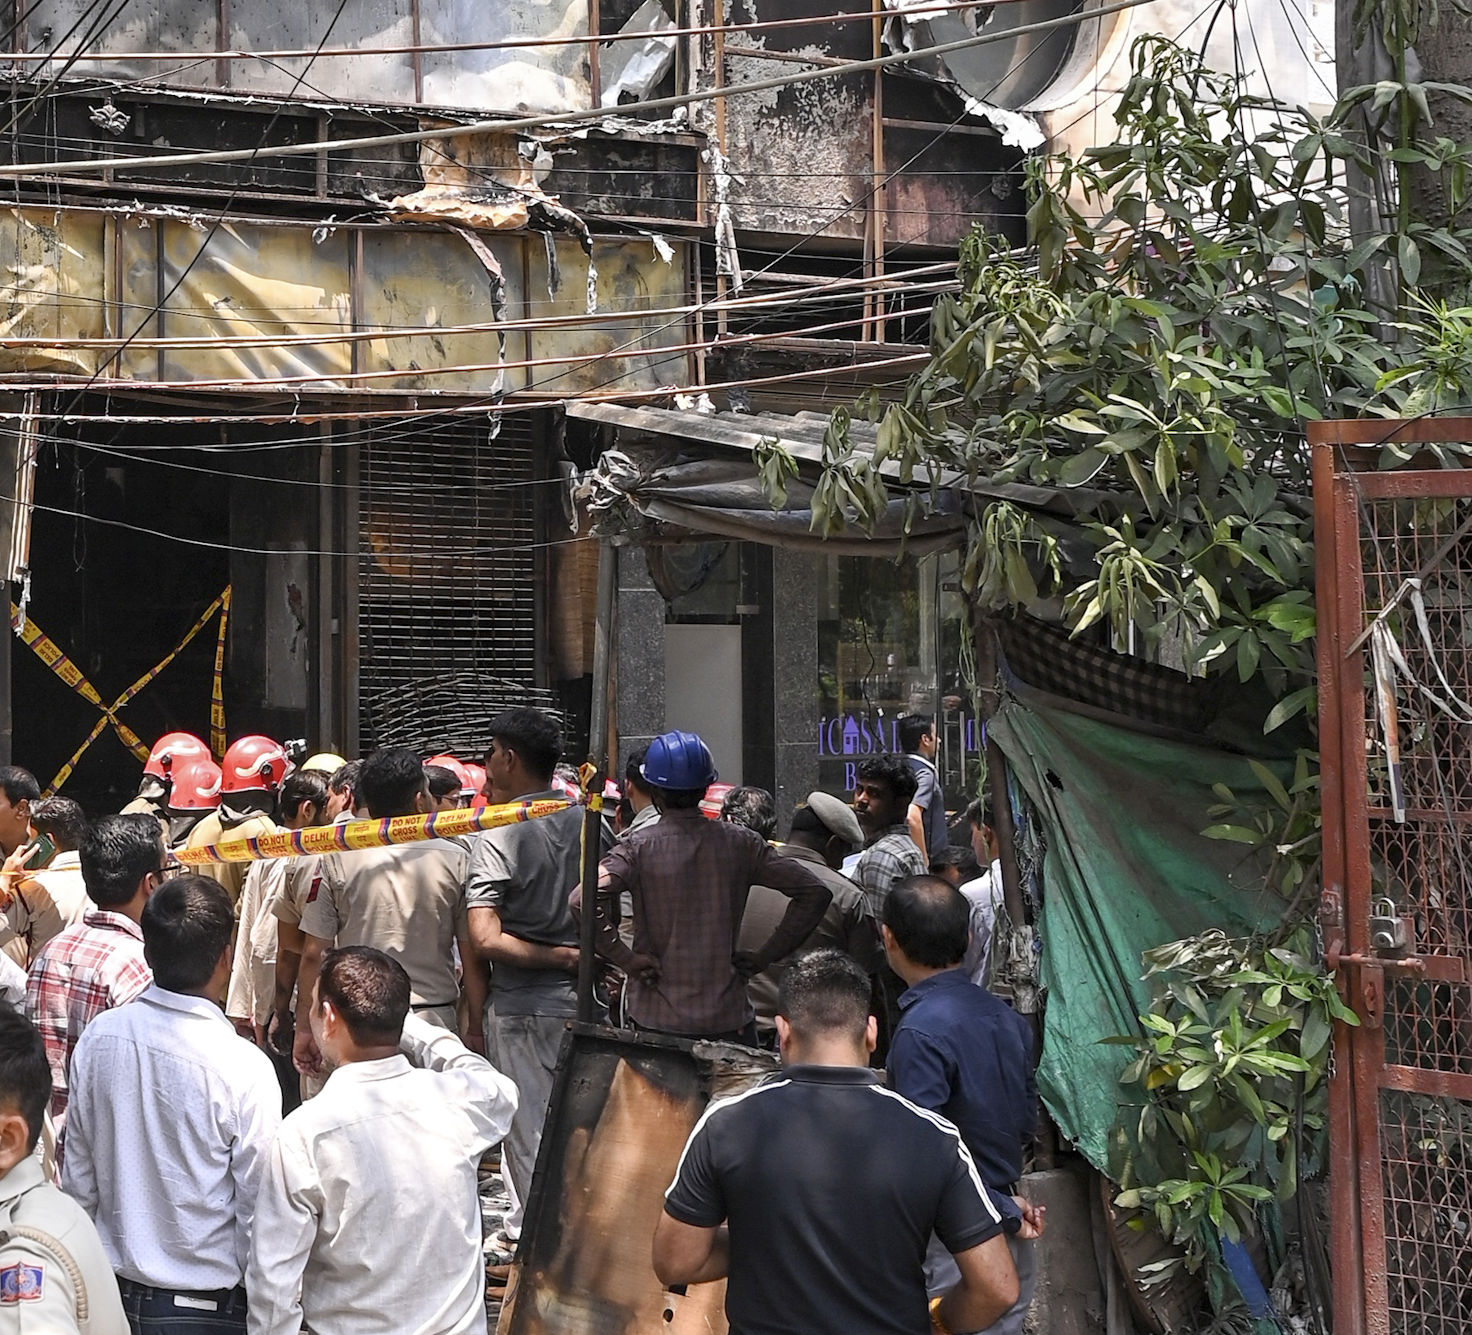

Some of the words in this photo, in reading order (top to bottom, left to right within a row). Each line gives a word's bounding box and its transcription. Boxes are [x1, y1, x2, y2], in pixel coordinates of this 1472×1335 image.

[392, 818, 404, 827] DO
[405, 816, 421, 826] NOT
[440, 813, 467, 823] DELHI
[392, 826, 418, 837] CROSS
[437, 825, 472, 836] POLICE
[258, 838, 268, 847] DO
[270, 835, 286, 845] NOT
[303, 831, 329, 843] DELHI
